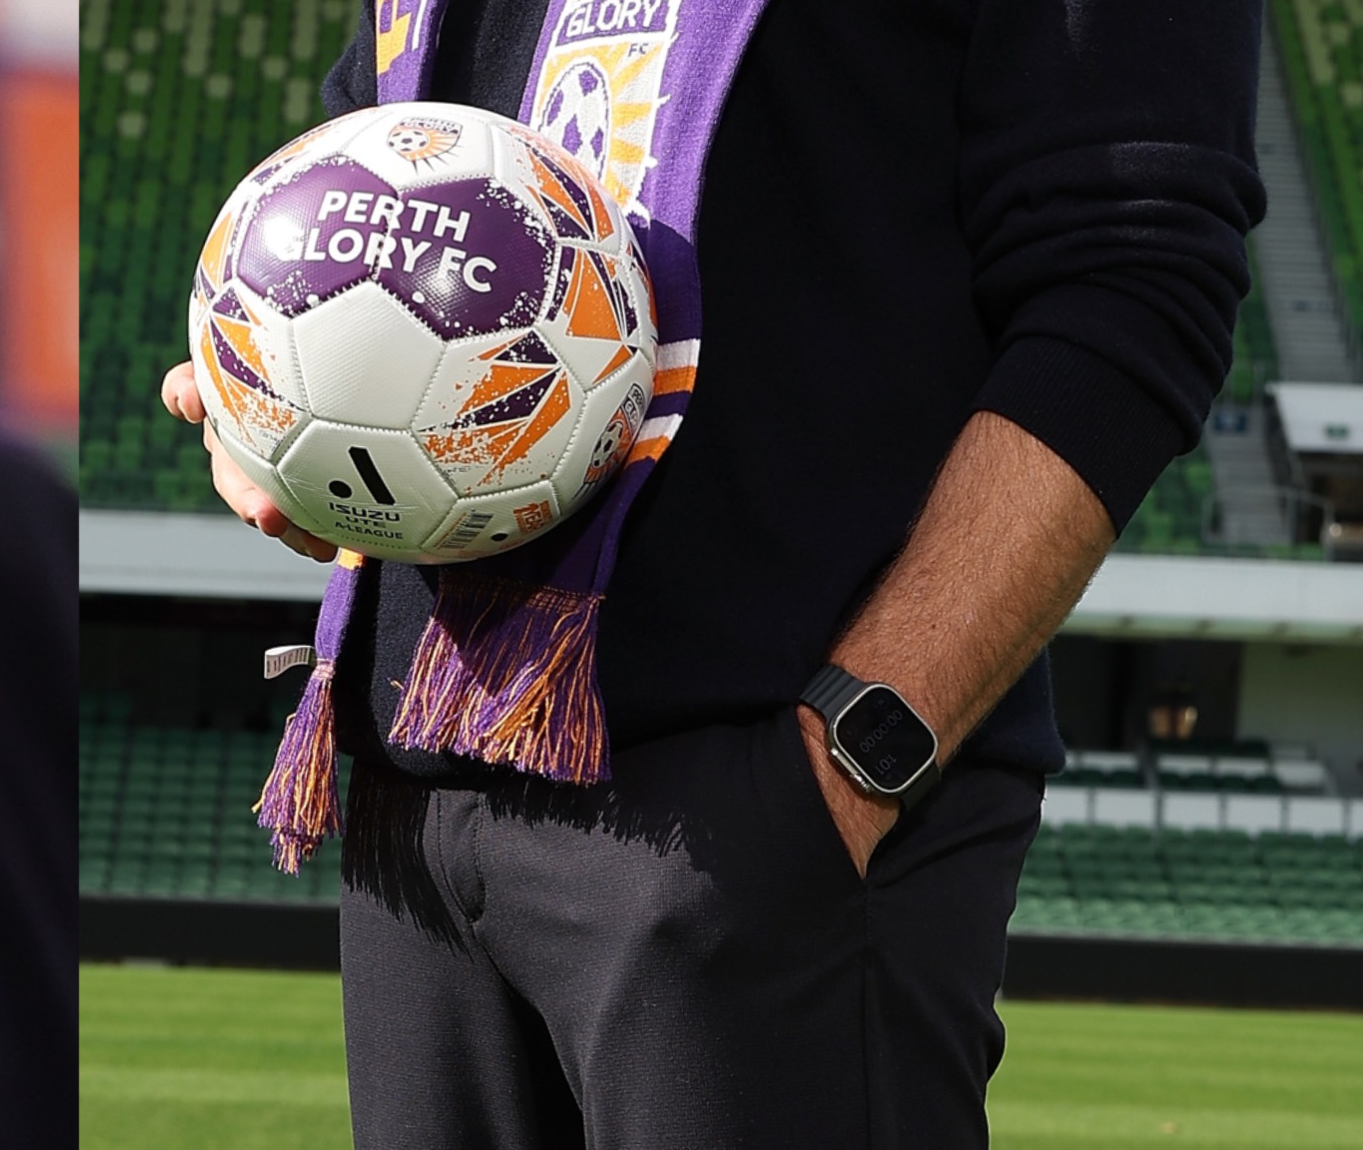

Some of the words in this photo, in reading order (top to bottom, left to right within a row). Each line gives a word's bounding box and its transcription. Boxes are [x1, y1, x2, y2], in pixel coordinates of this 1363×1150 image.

[628, 42, 649, 57] FC
[317, 190, 471, 242] PERTH
[277, 228, 432, 273] GLORY
[437, 246, 497, 293] FC
[329, 502, 401, 522] ISUZU
[345, 515, 387, 529] UTE
